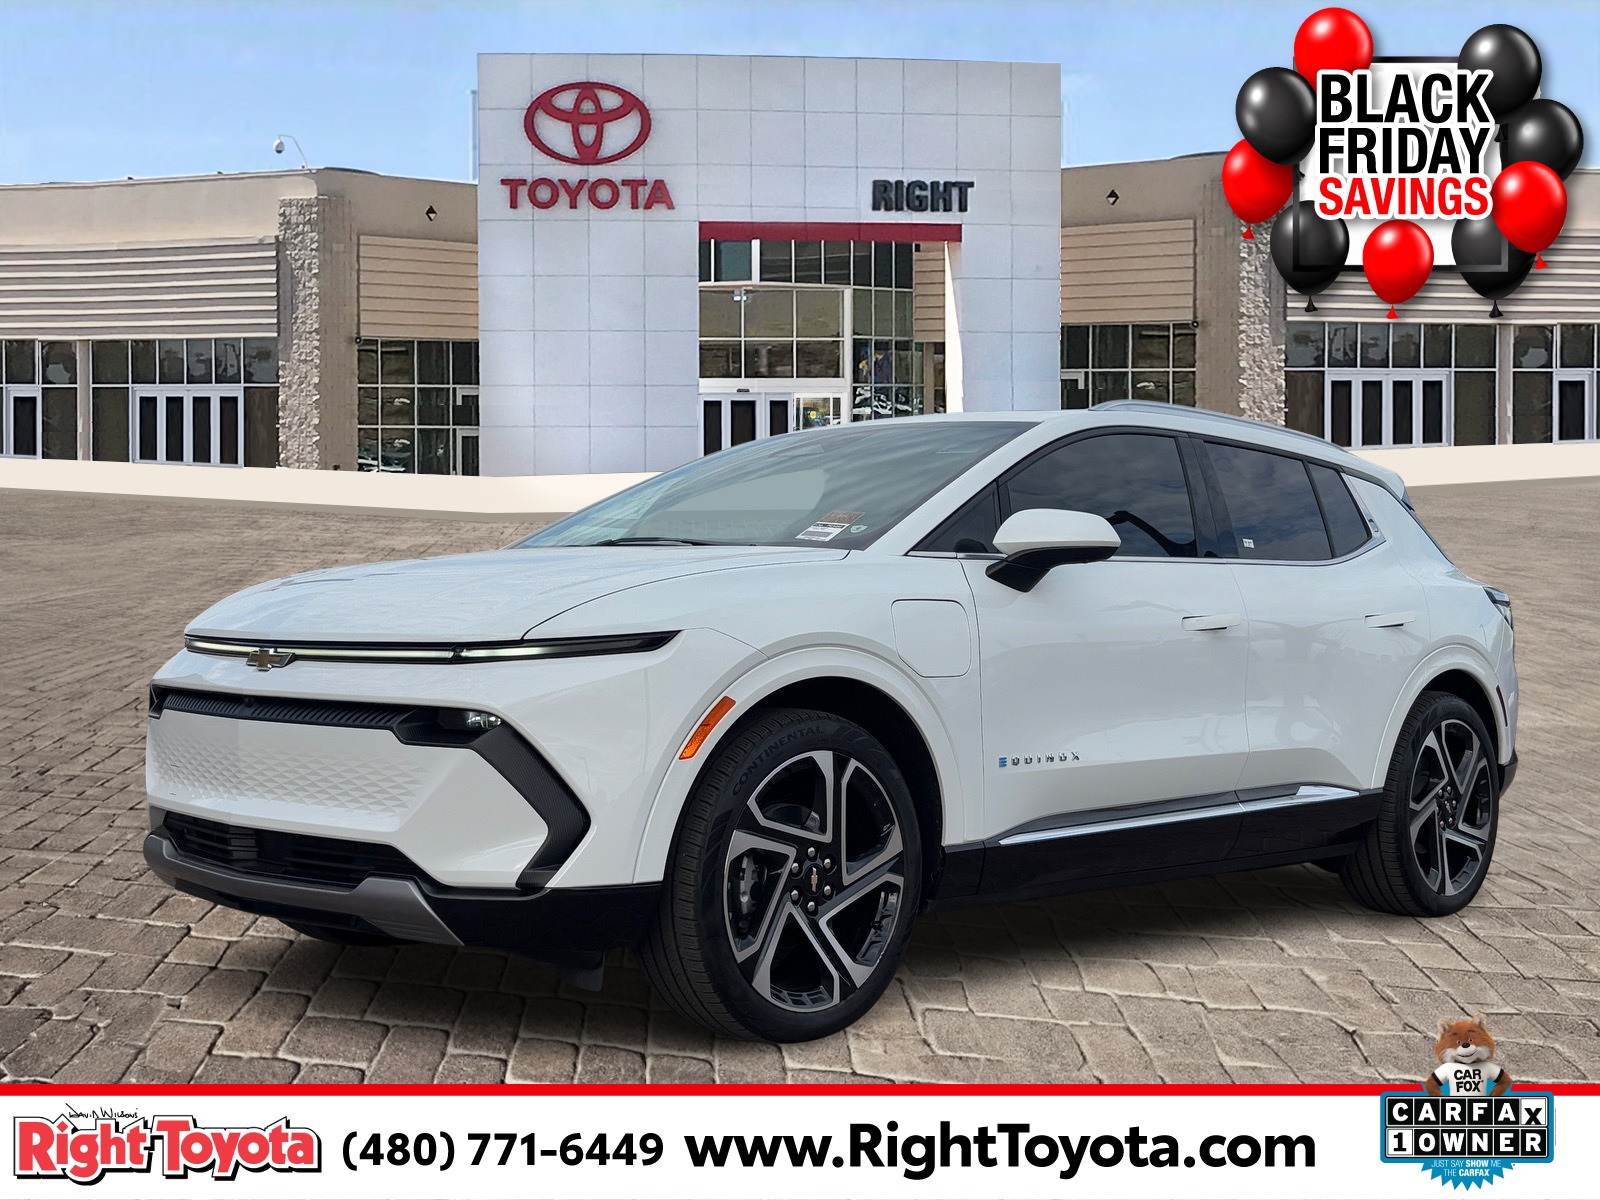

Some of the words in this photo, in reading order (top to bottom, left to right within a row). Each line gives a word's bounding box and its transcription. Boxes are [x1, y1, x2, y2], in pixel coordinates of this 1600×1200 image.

[501, 179, 675, 210] TOYOTA
[872, 179, 976, 213] RIGHT
[732, 725, 825, 797] CONTINENTAL
[998, 751, 1081, 768] EQUINOX
